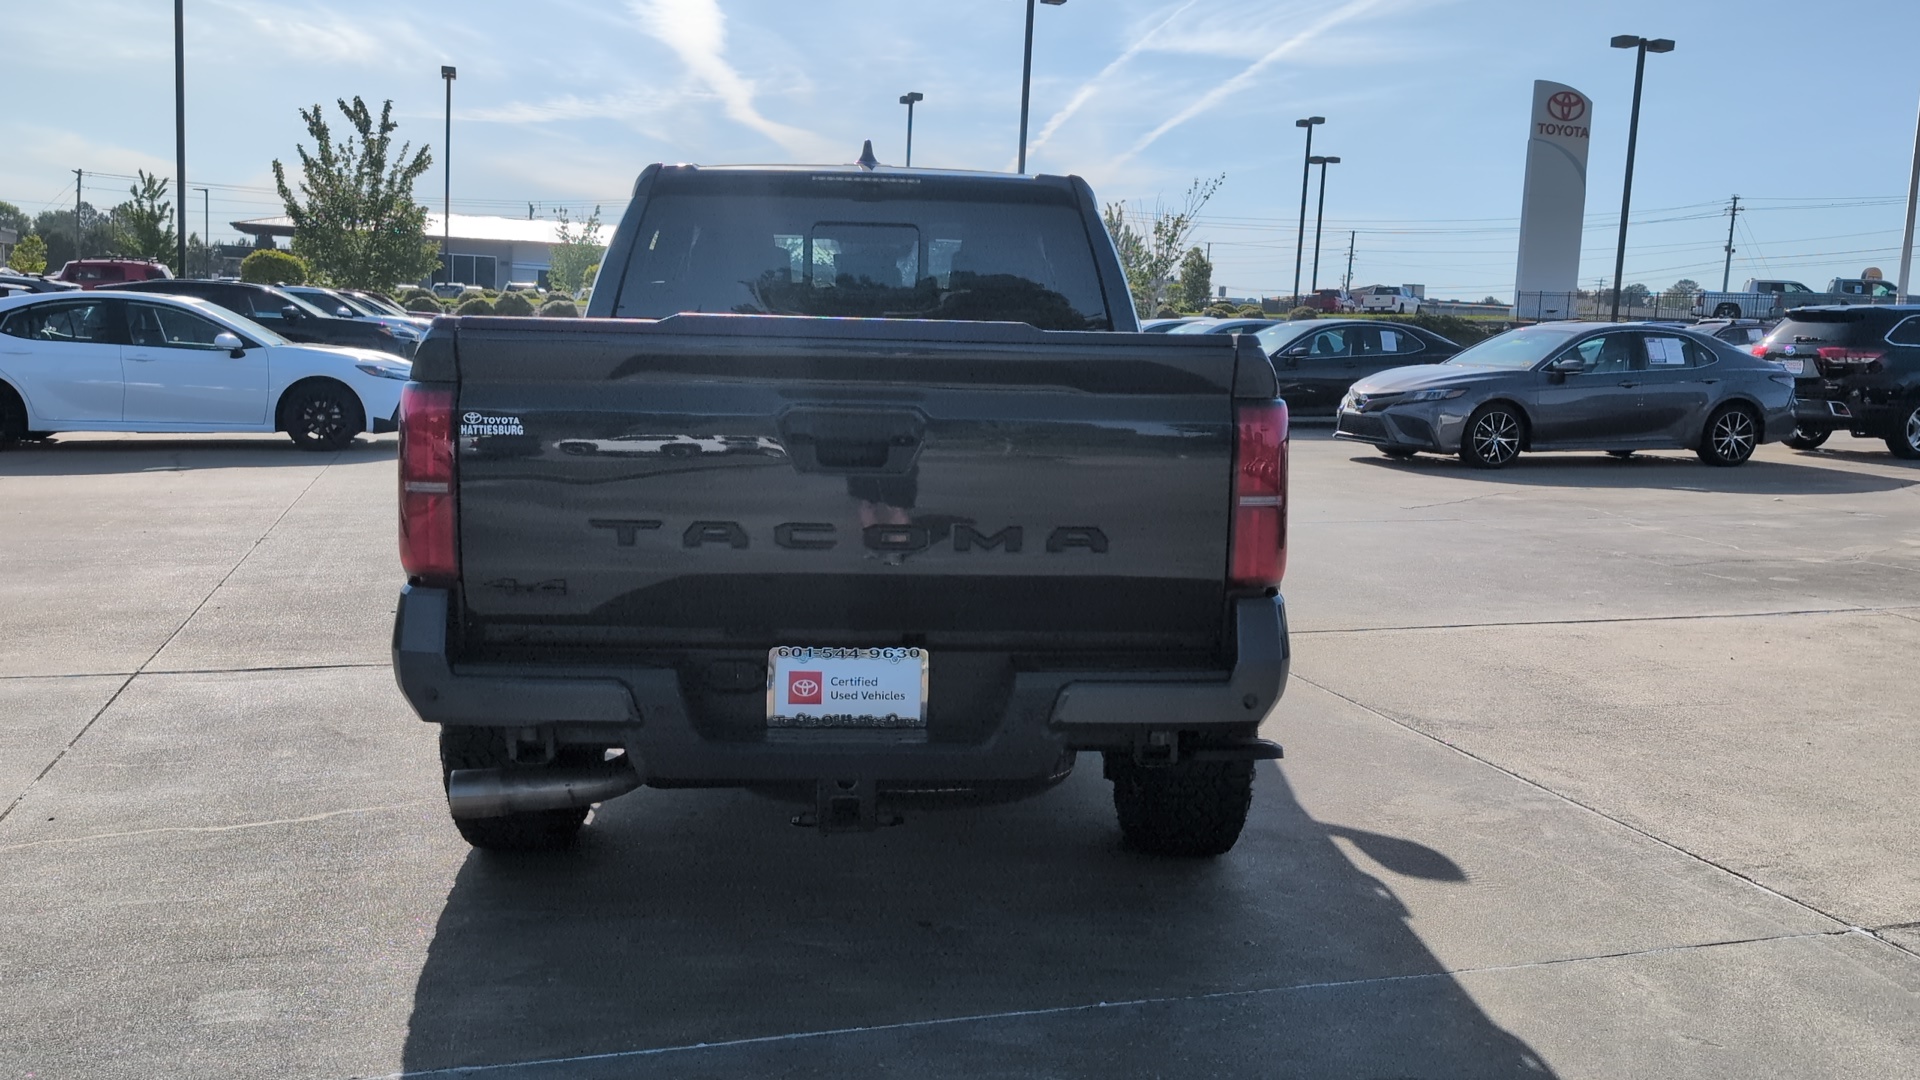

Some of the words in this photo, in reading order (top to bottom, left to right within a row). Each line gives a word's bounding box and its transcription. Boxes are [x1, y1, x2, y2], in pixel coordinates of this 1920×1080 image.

[1537, 122, 1590, 139] TOYOTA
[482, 416, 520, 424] TOYOTA
[460, 424, 524, 436] HATTIESBURG
[588, 518, 1109, 553] TACOMA
[778, 647, 920, 659] 601-544-9630
[830, 676, 878, 687] Certified
[830, 690, 858, 701] Used
[861, 690, 906, 701] Vehicles
[774, 714, 819, 727] Tota
[841, 714, 918, 727] Hattiesurg
